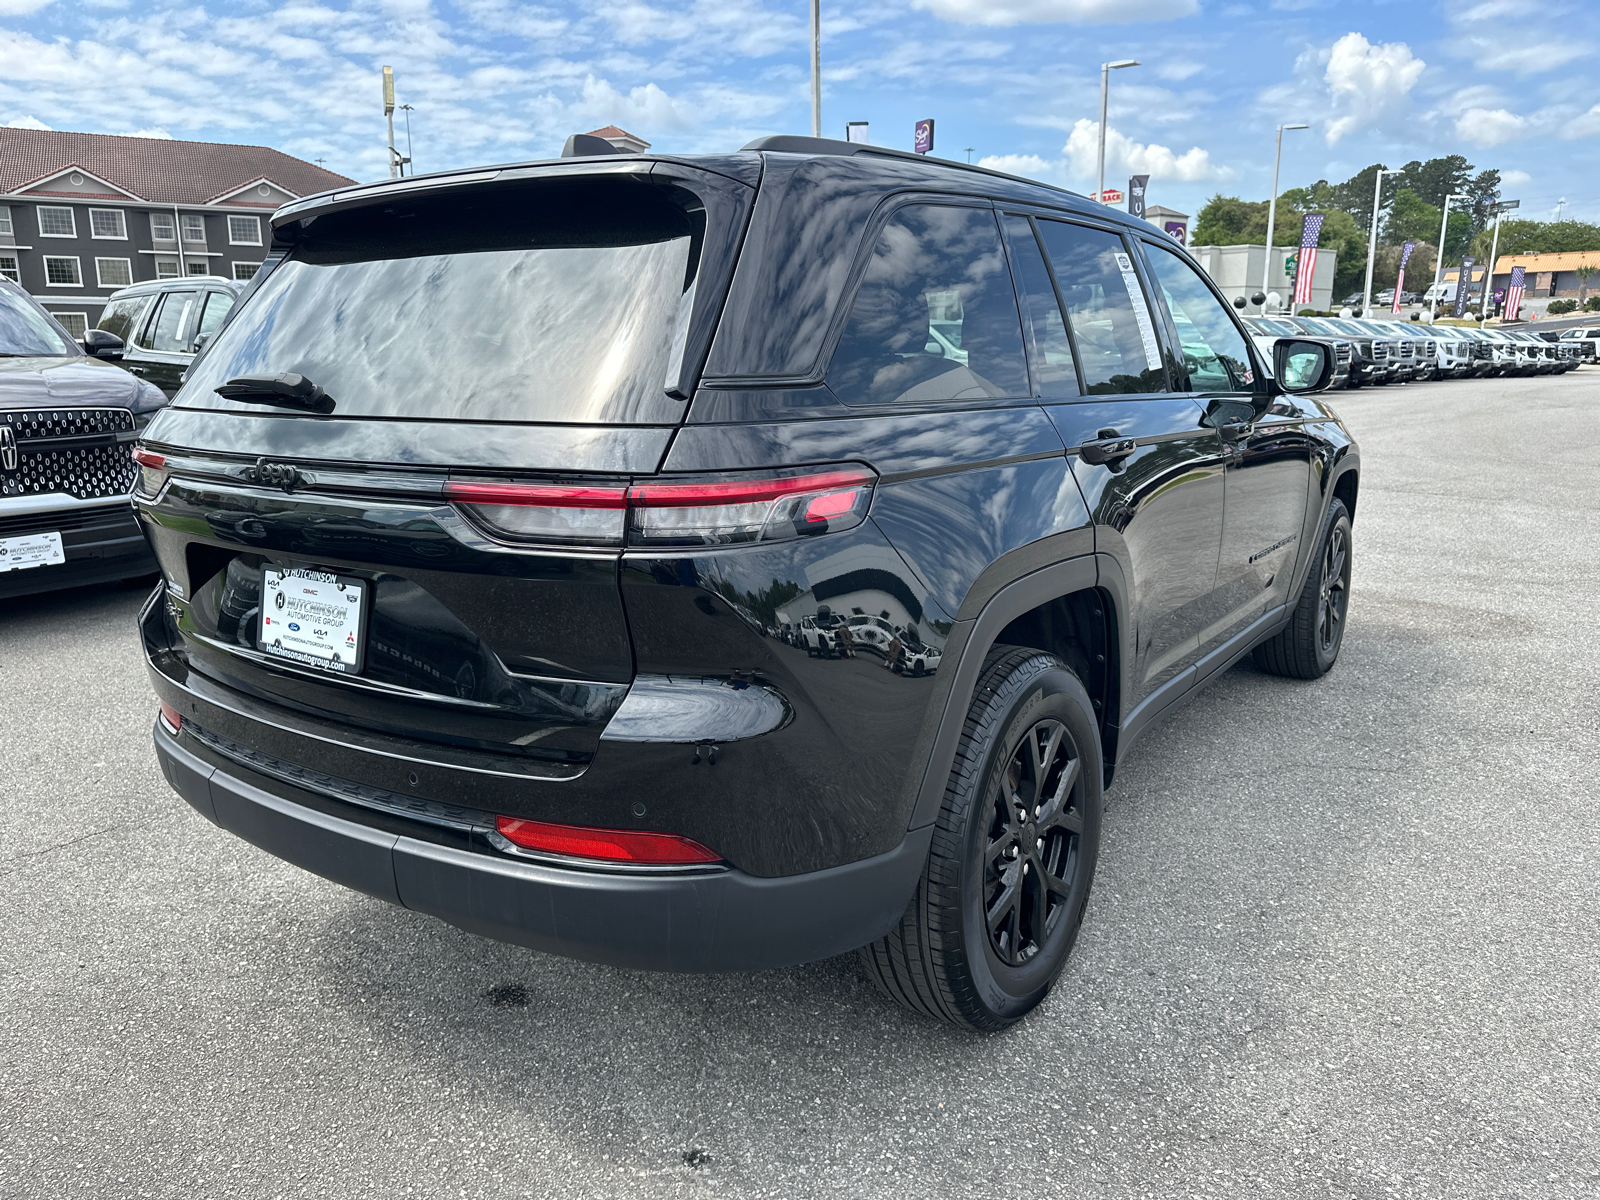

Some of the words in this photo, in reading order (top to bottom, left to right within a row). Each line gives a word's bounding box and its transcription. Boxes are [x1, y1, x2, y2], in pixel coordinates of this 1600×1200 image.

[1456, 270, 1469, 315] CADILLAC
[245, 456, 298, 496] Jeep
[291, 569, 338, 584] HUTCHINSON
[303, 588, 318, 596] GMC
[287, 596, 348, 620] HUTCHINSON
[286, 610, 322, 625] AUTOMOTIVE
[322, 617, 344, 628] GROUP
[313, 628, 328, 637] KIA
[265, 643, 346, 672] Hutchinsonautogroup.com
